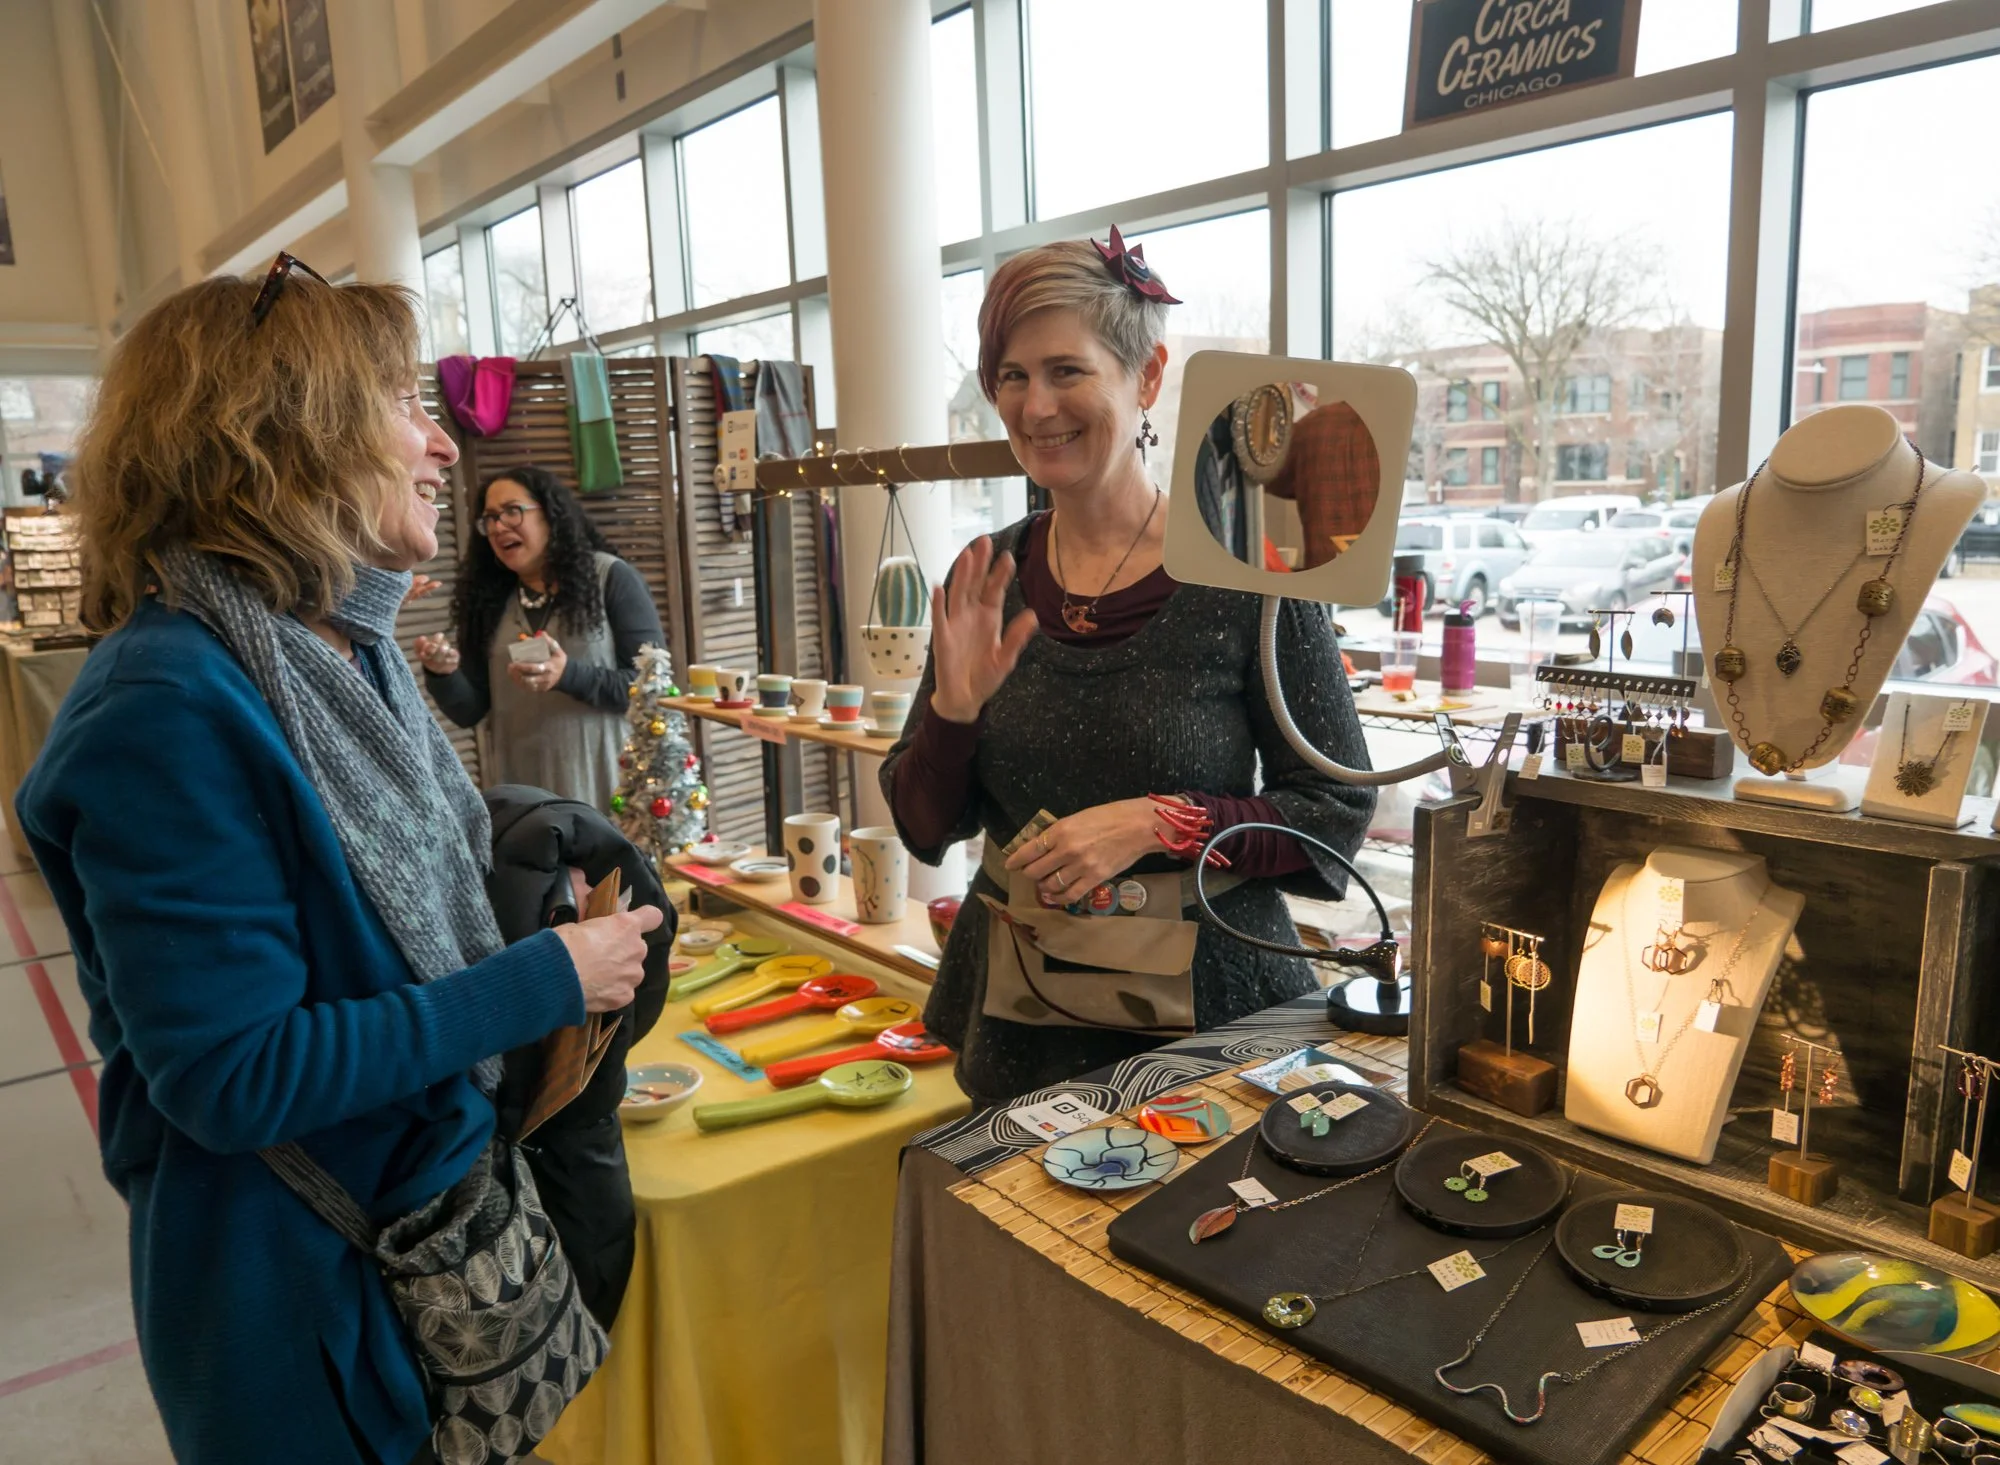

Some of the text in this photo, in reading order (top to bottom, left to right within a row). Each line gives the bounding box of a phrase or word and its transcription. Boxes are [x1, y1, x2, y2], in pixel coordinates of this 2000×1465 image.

[1474, 0, 1569, 45] CIRCA
[1437, 19, 1602, 96] CERAMICS
[1464, 73, 1562, 108] CHICAGO
